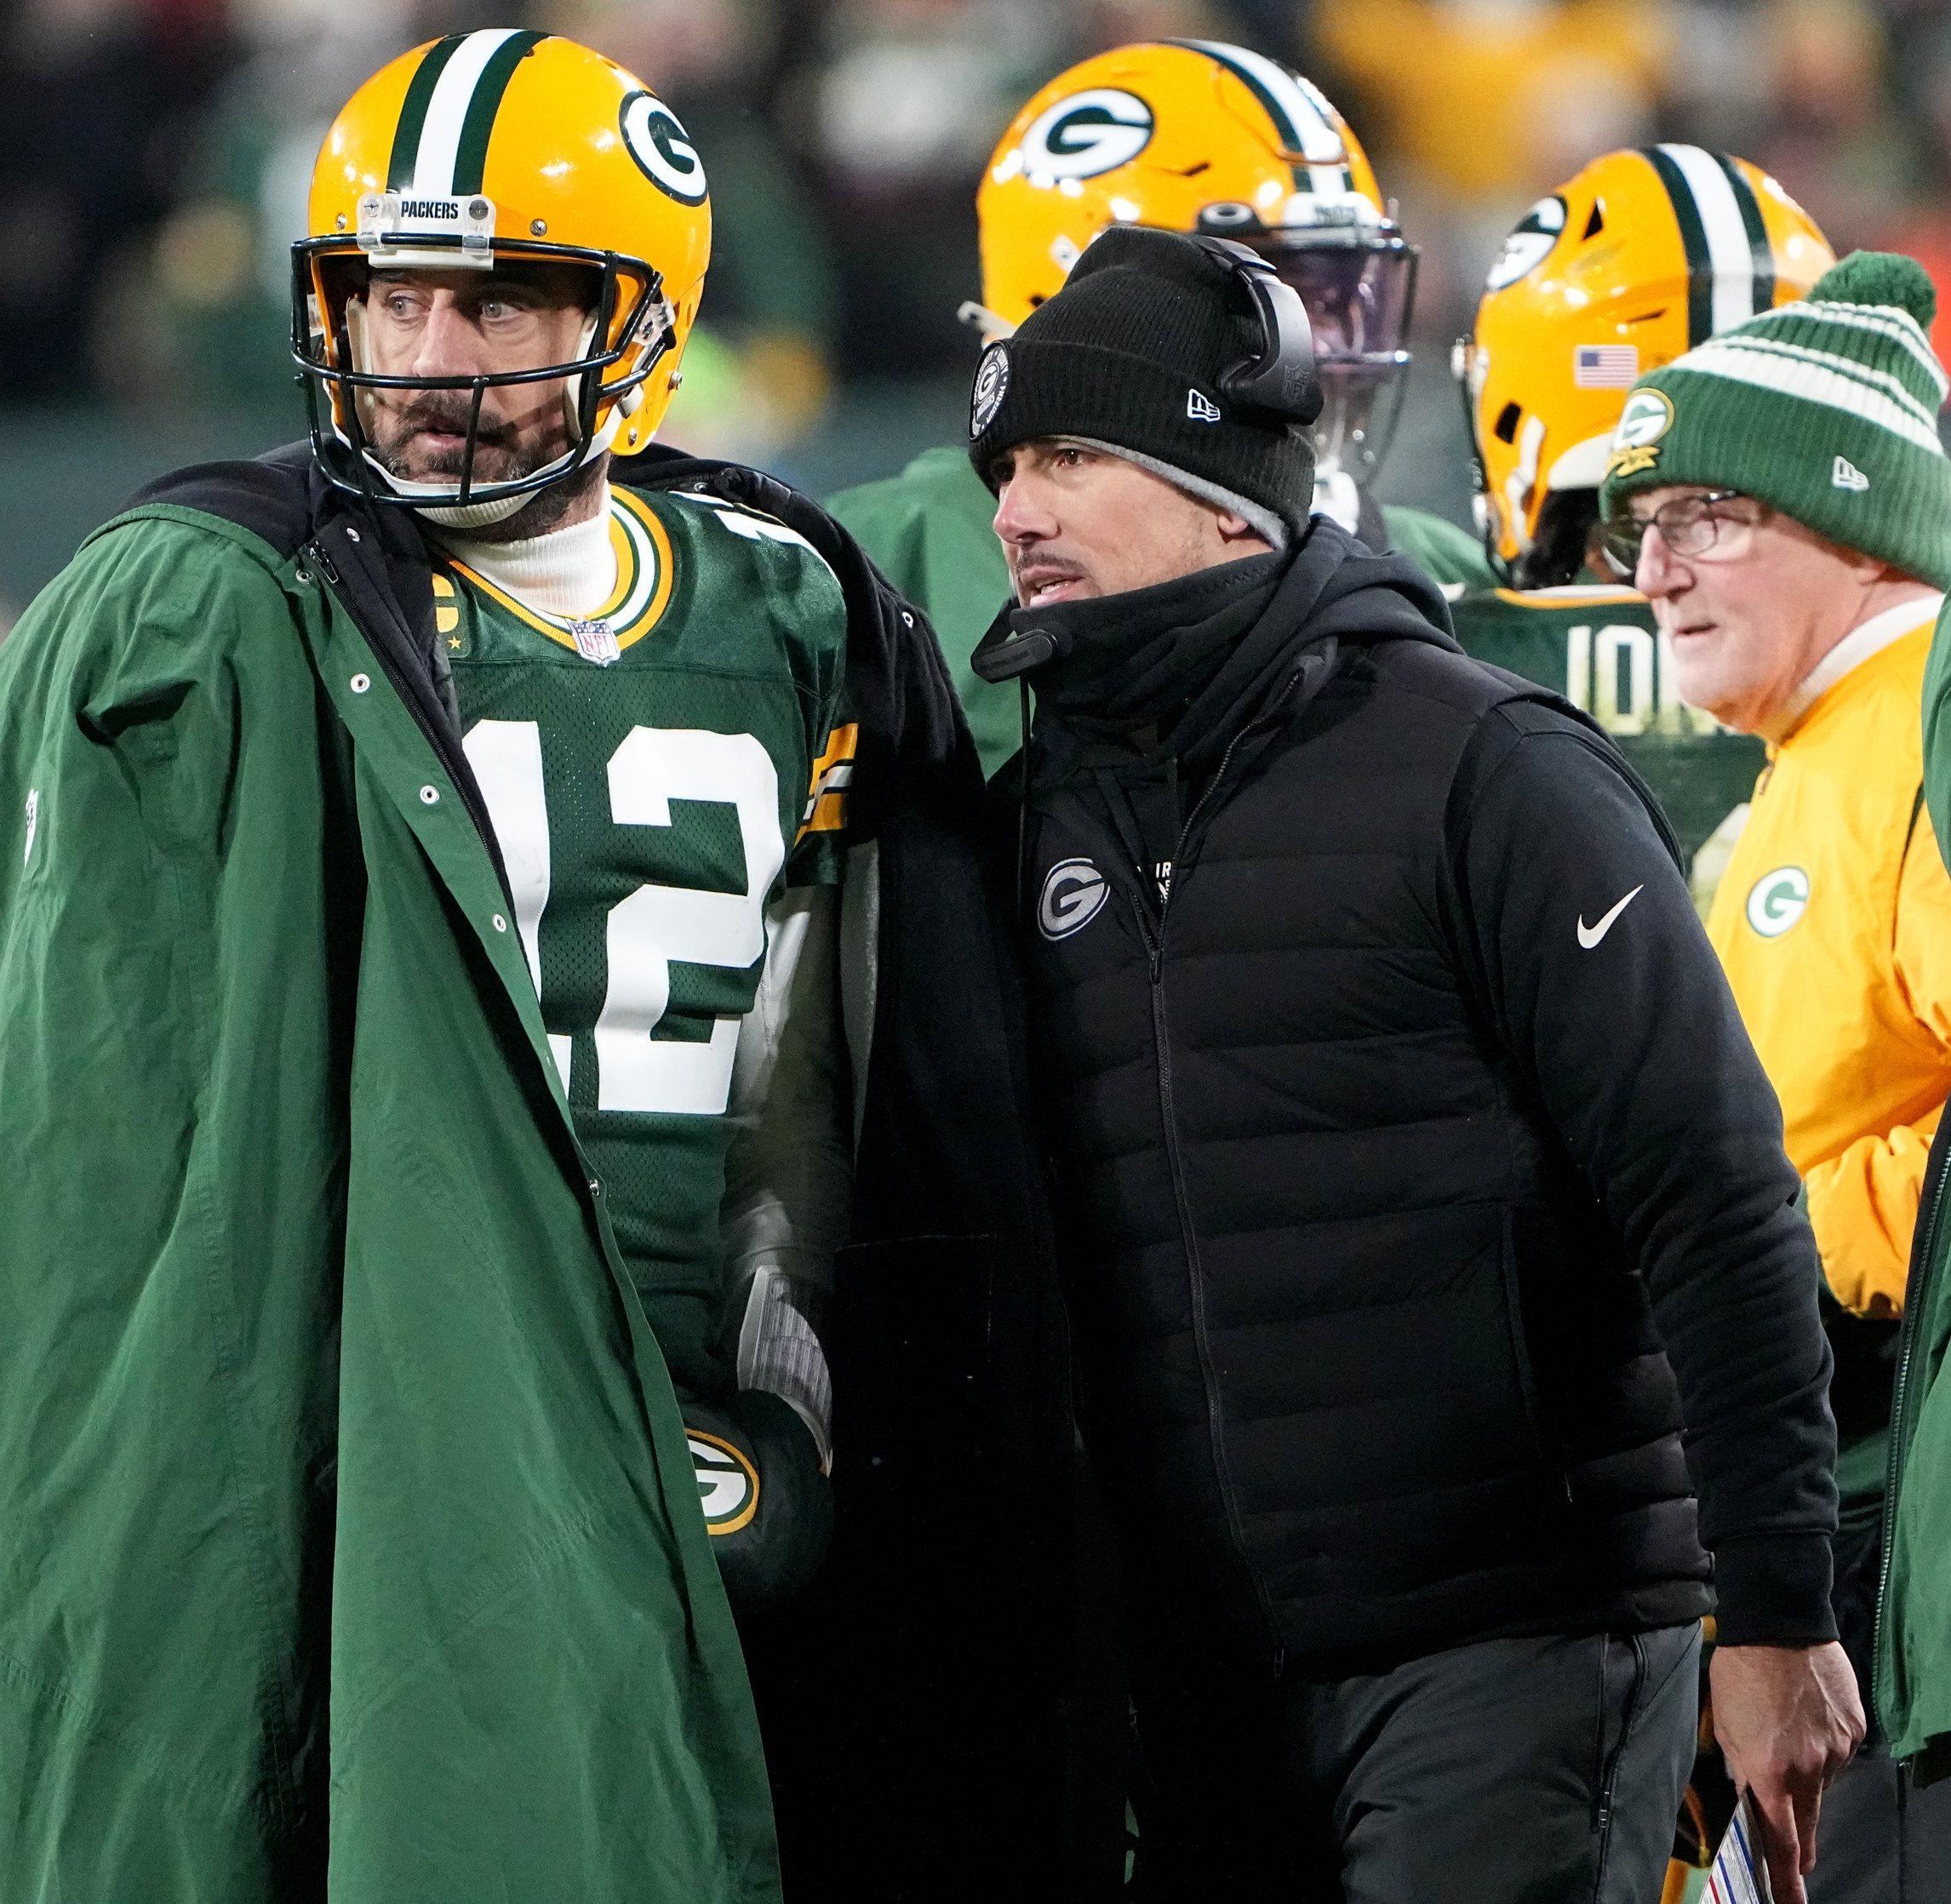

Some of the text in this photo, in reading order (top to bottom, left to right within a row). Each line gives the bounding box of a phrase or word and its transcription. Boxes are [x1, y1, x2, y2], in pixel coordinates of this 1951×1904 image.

[621, 91, 707, 205] G
[401, 201, 459, 219] PACKERS
[462, 719, 785, 1114] 12
